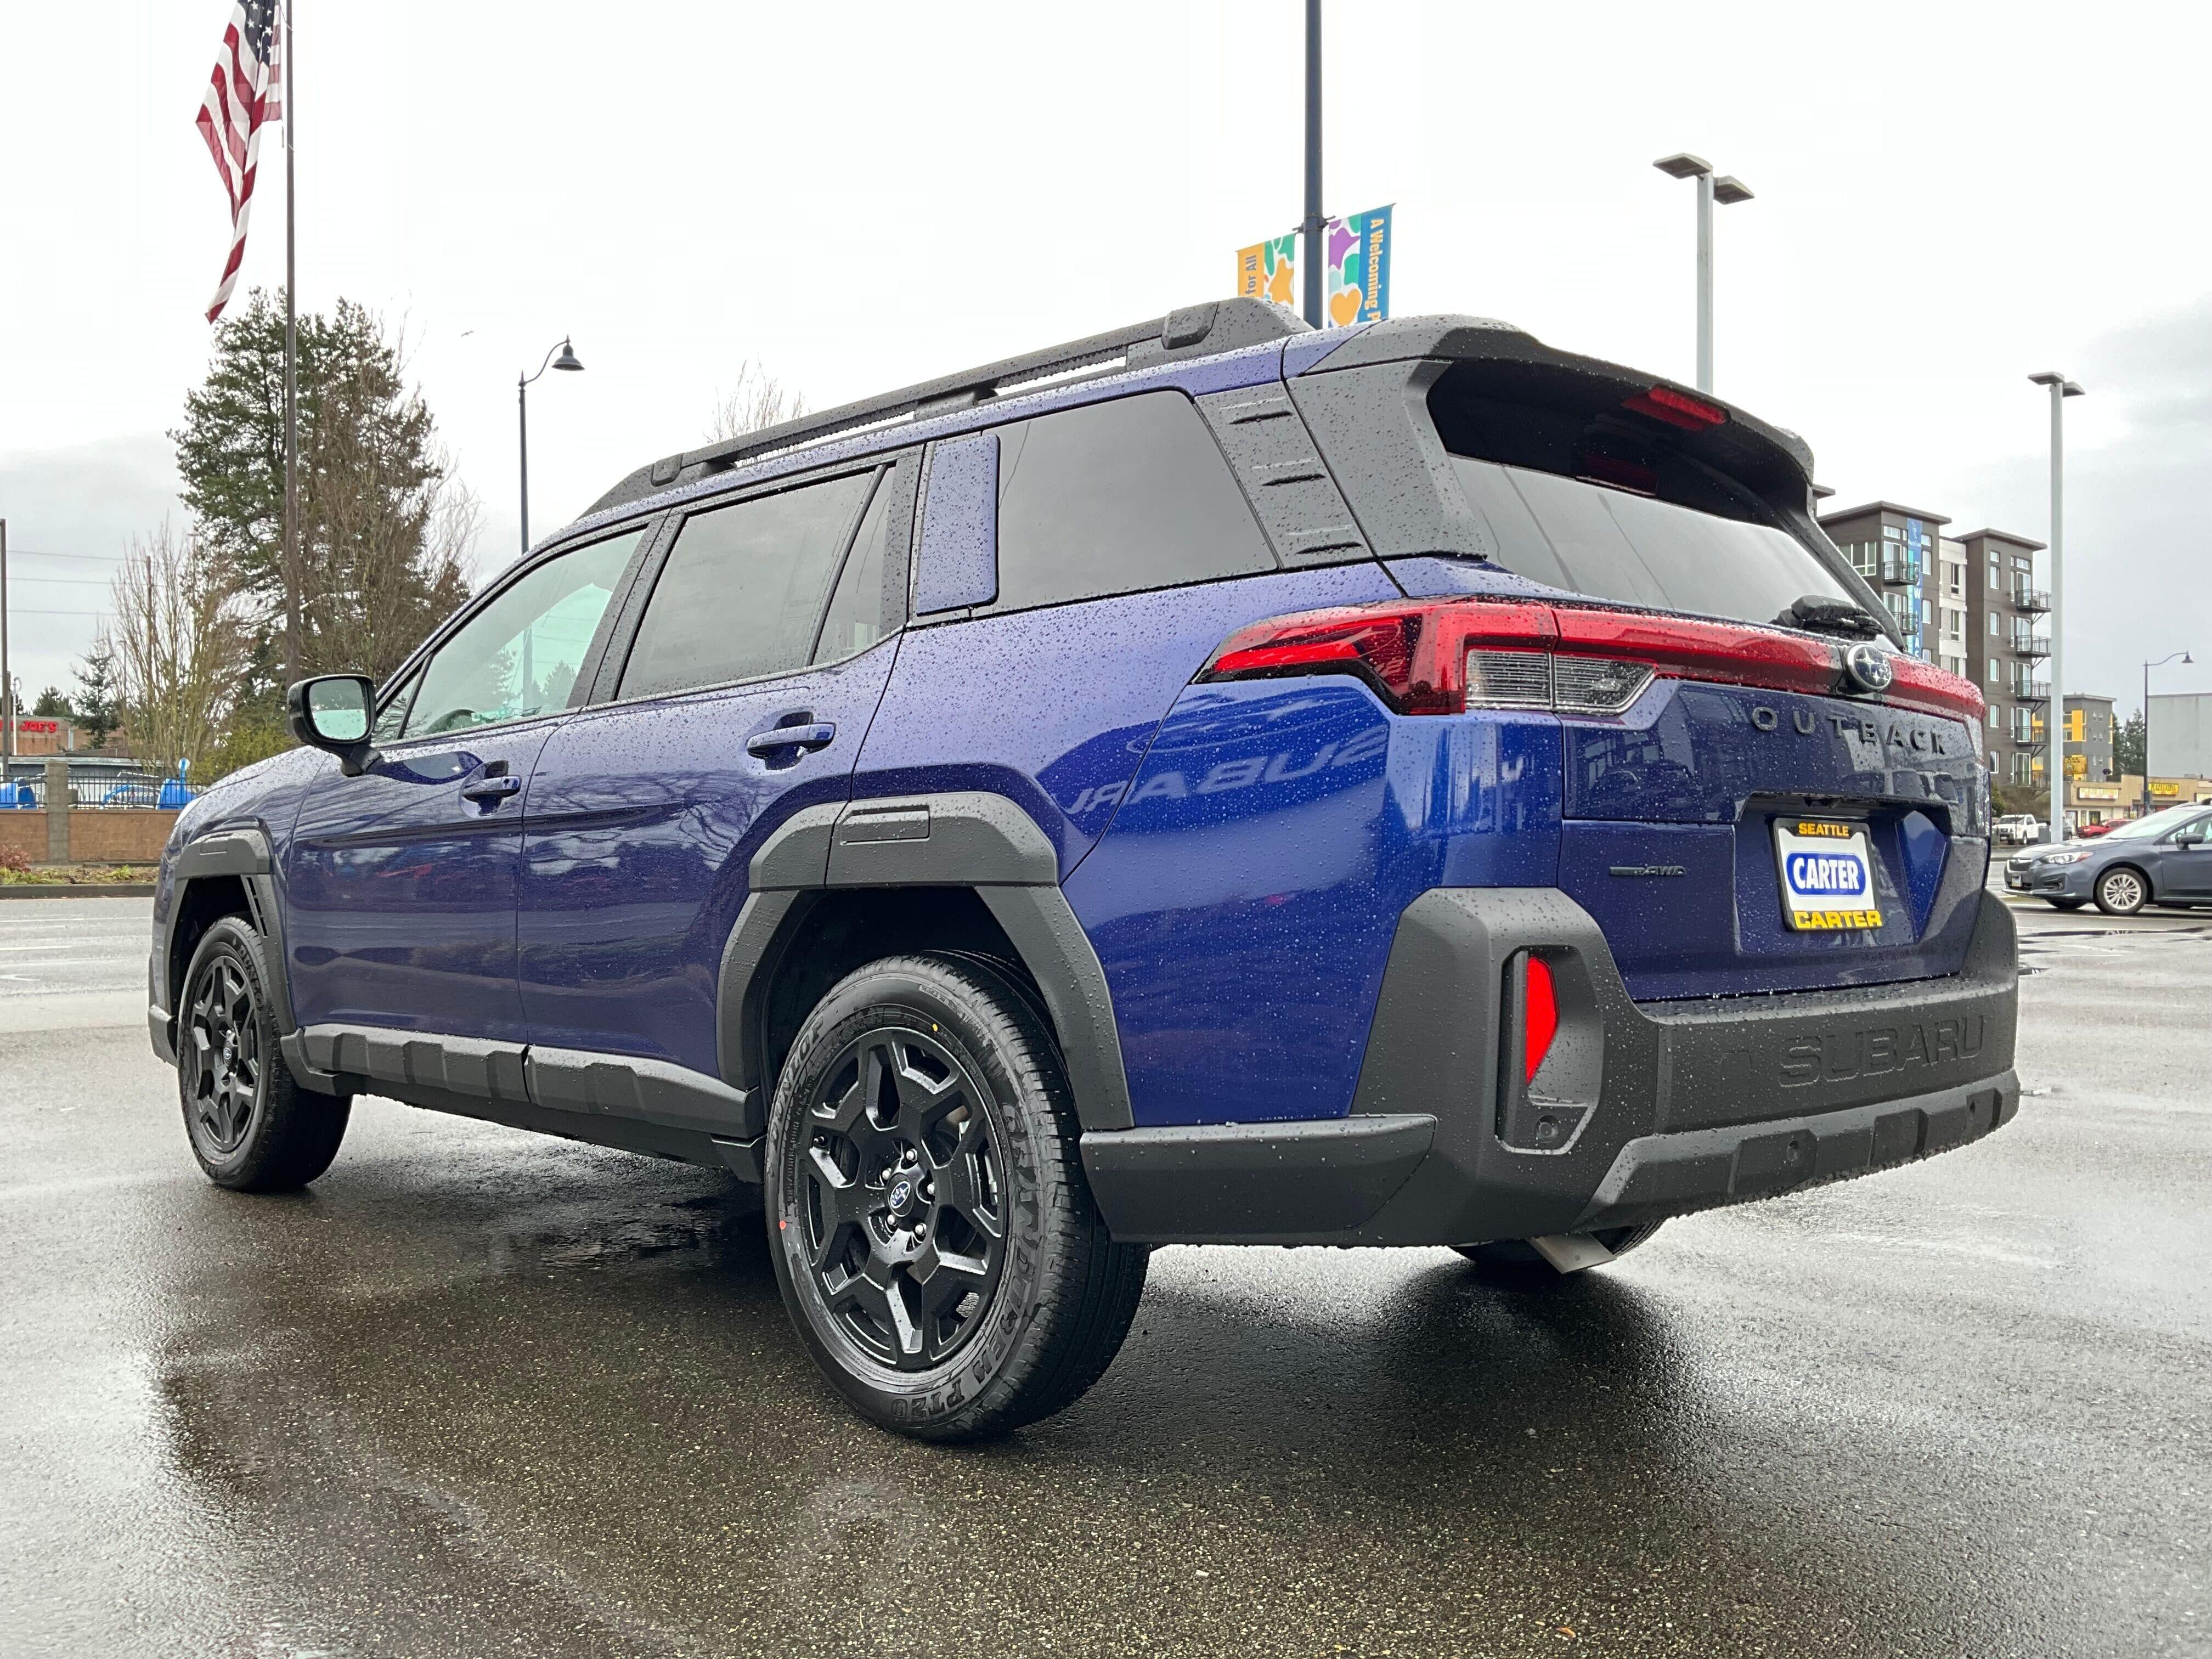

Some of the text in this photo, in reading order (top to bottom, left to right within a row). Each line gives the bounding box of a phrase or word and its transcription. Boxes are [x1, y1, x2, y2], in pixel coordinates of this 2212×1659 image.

[1370, 218, 1384, 229] A
[1245, 254, 1257, 295] for All
[1364, 229, 1384, 310] Welcoming
[20, 720, 57, 732] JOE'S
[1751, 706, 1945, 755] OUTBACK
[1798, 823, 1849, 837] SEATTLE
[1793, 857, 1860, 890] CARTER
[1793, 910, 1882, 929] CARTER
[1778, 1014, 1984, 1088] SUBARU
[768, 1020, 823, 1148] DUNLOP
[891, 1379, 965, 1419] PT20
